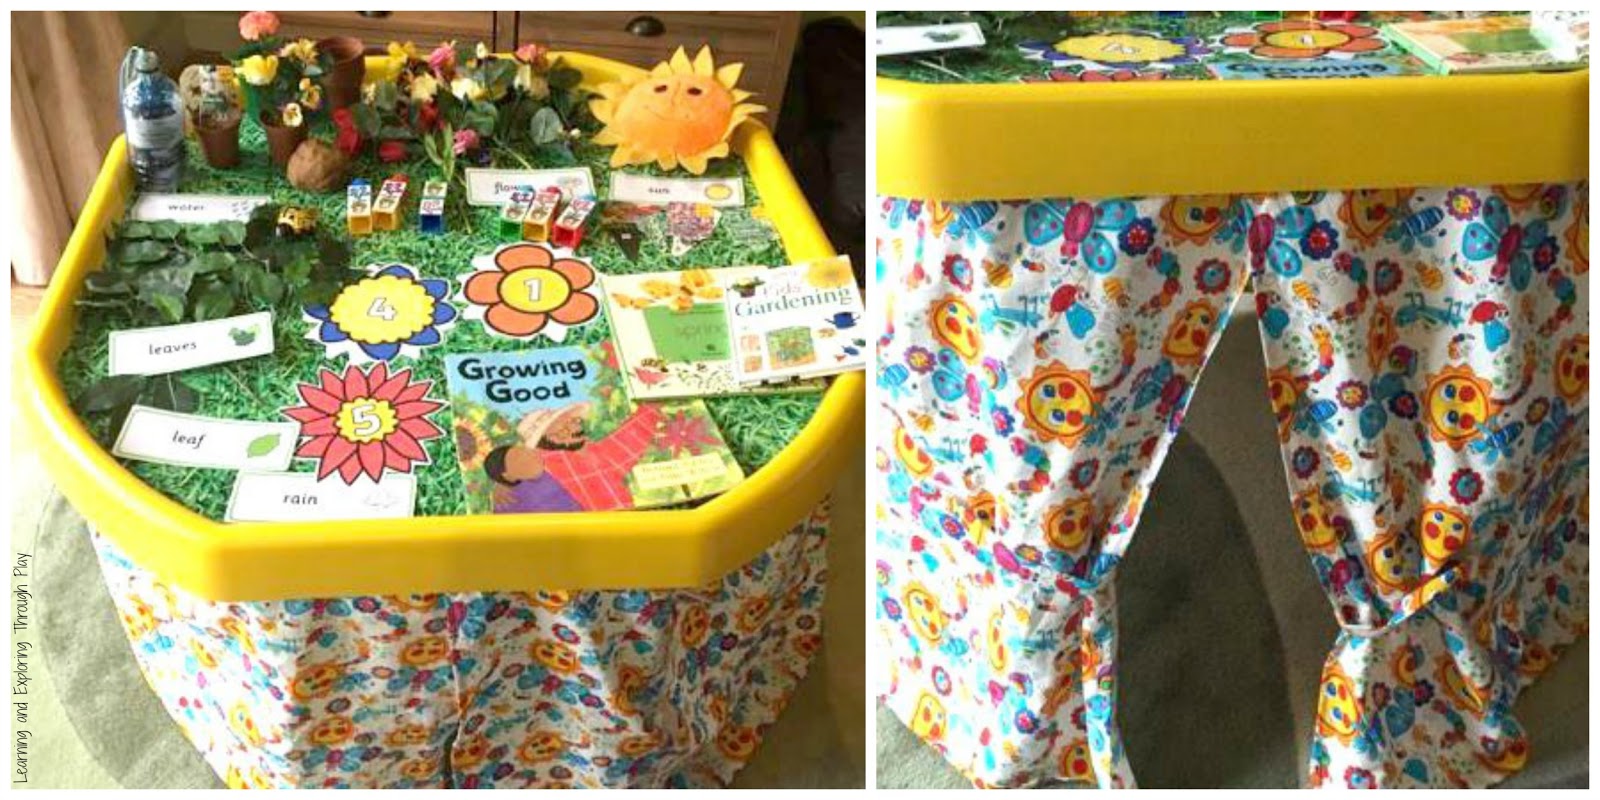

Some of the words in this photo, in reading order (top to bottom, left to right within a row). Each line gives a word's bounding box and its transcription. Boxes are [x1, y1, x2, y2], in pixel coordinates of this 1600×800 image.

[648, 187, 669, 195] sun
[168, 204, 206, 212] water
[523, 276, 543, 302] 1
[734, 286, 852, 317] Gardening
[366, 296, 400, 322] 4
[148, 339, 198, 356] leaves
[457, 356, 588, 381] Growing
[484, 378, 572, 404] Good
[351, 403, 382, 437] 5
[171, 430, 208, 449] leaf
[282, 491, 320, 507] rain
